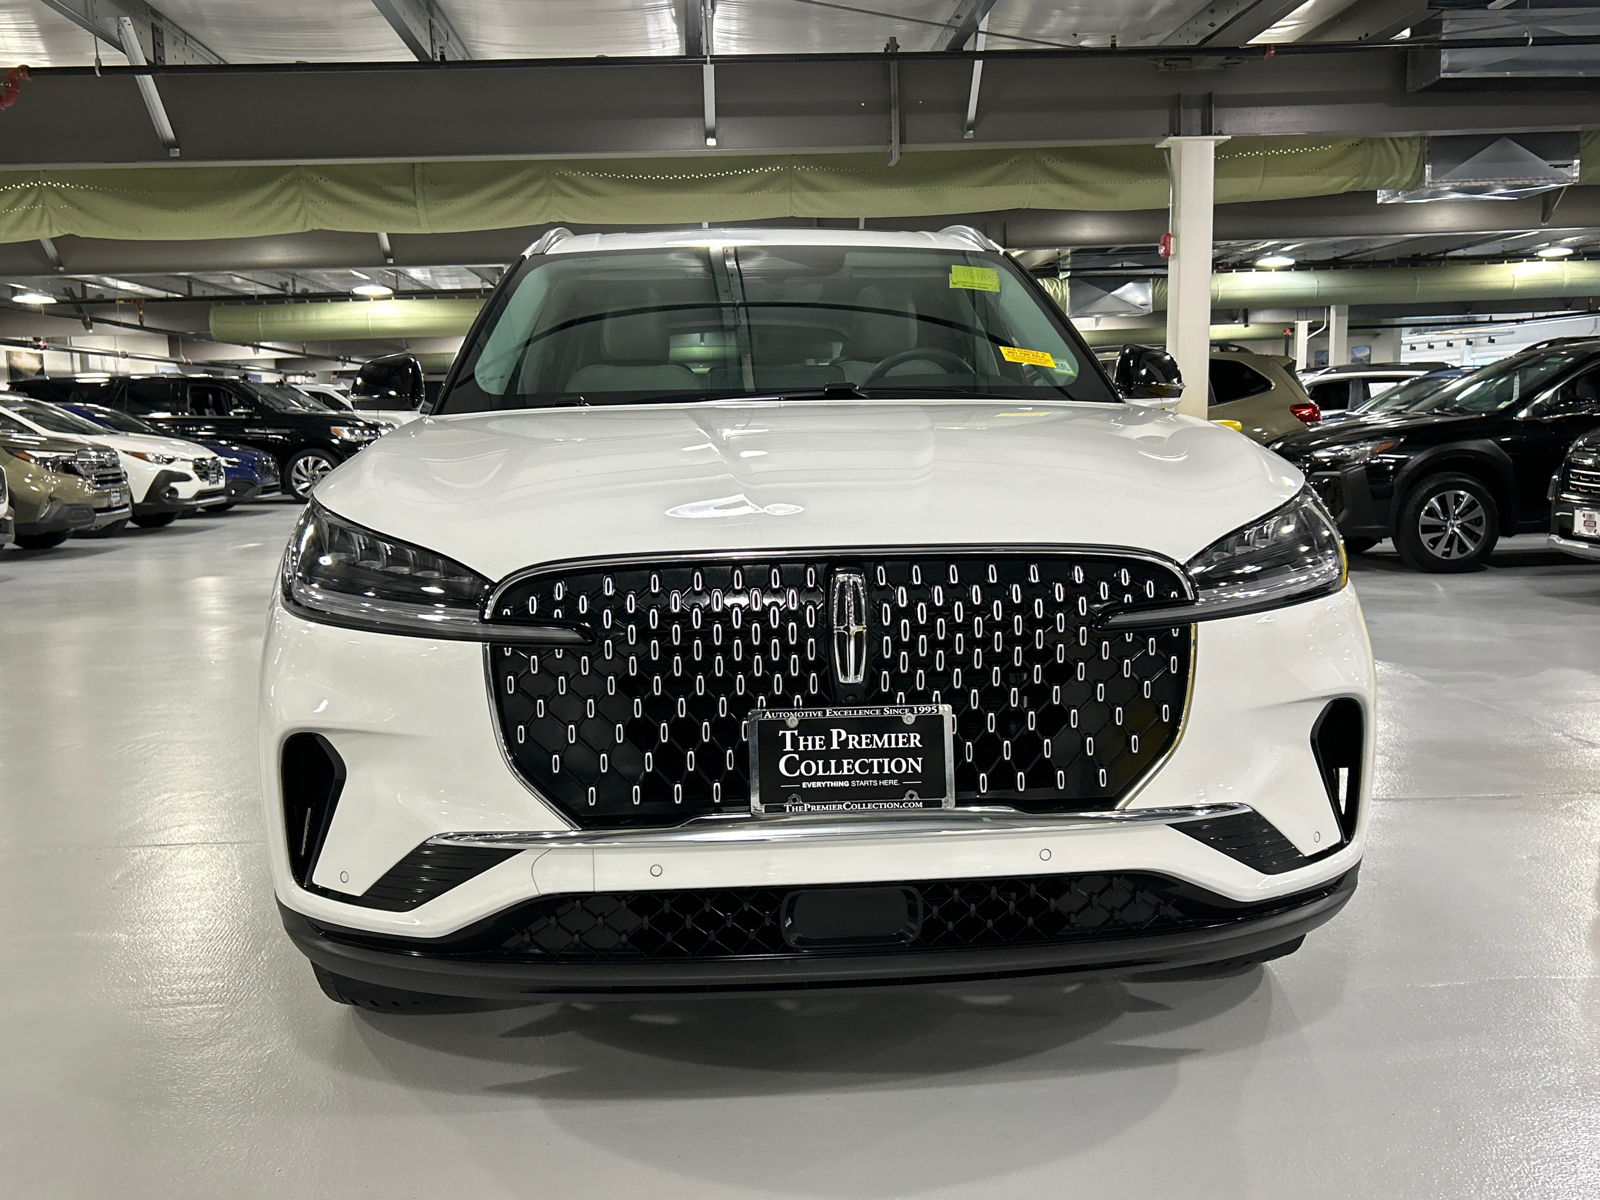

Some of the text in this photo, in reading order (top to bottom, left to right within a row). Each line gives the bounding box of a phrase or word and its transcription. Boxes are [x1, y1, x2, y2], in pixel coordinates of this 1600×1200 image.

[763, 705, 938, 719] AUTOMOTIVE EXCELLENCE SINCE 1995
[778, 728, 923, 752] THE PREMIER
[778, 753, 924, 778] COLLECTION
[801, 780, 850, 789] EVERYTHING
[850, 779, 878, 787] STARTS
[783, 801, 924, 813] THEPREMIERCOLLECTION.COM
